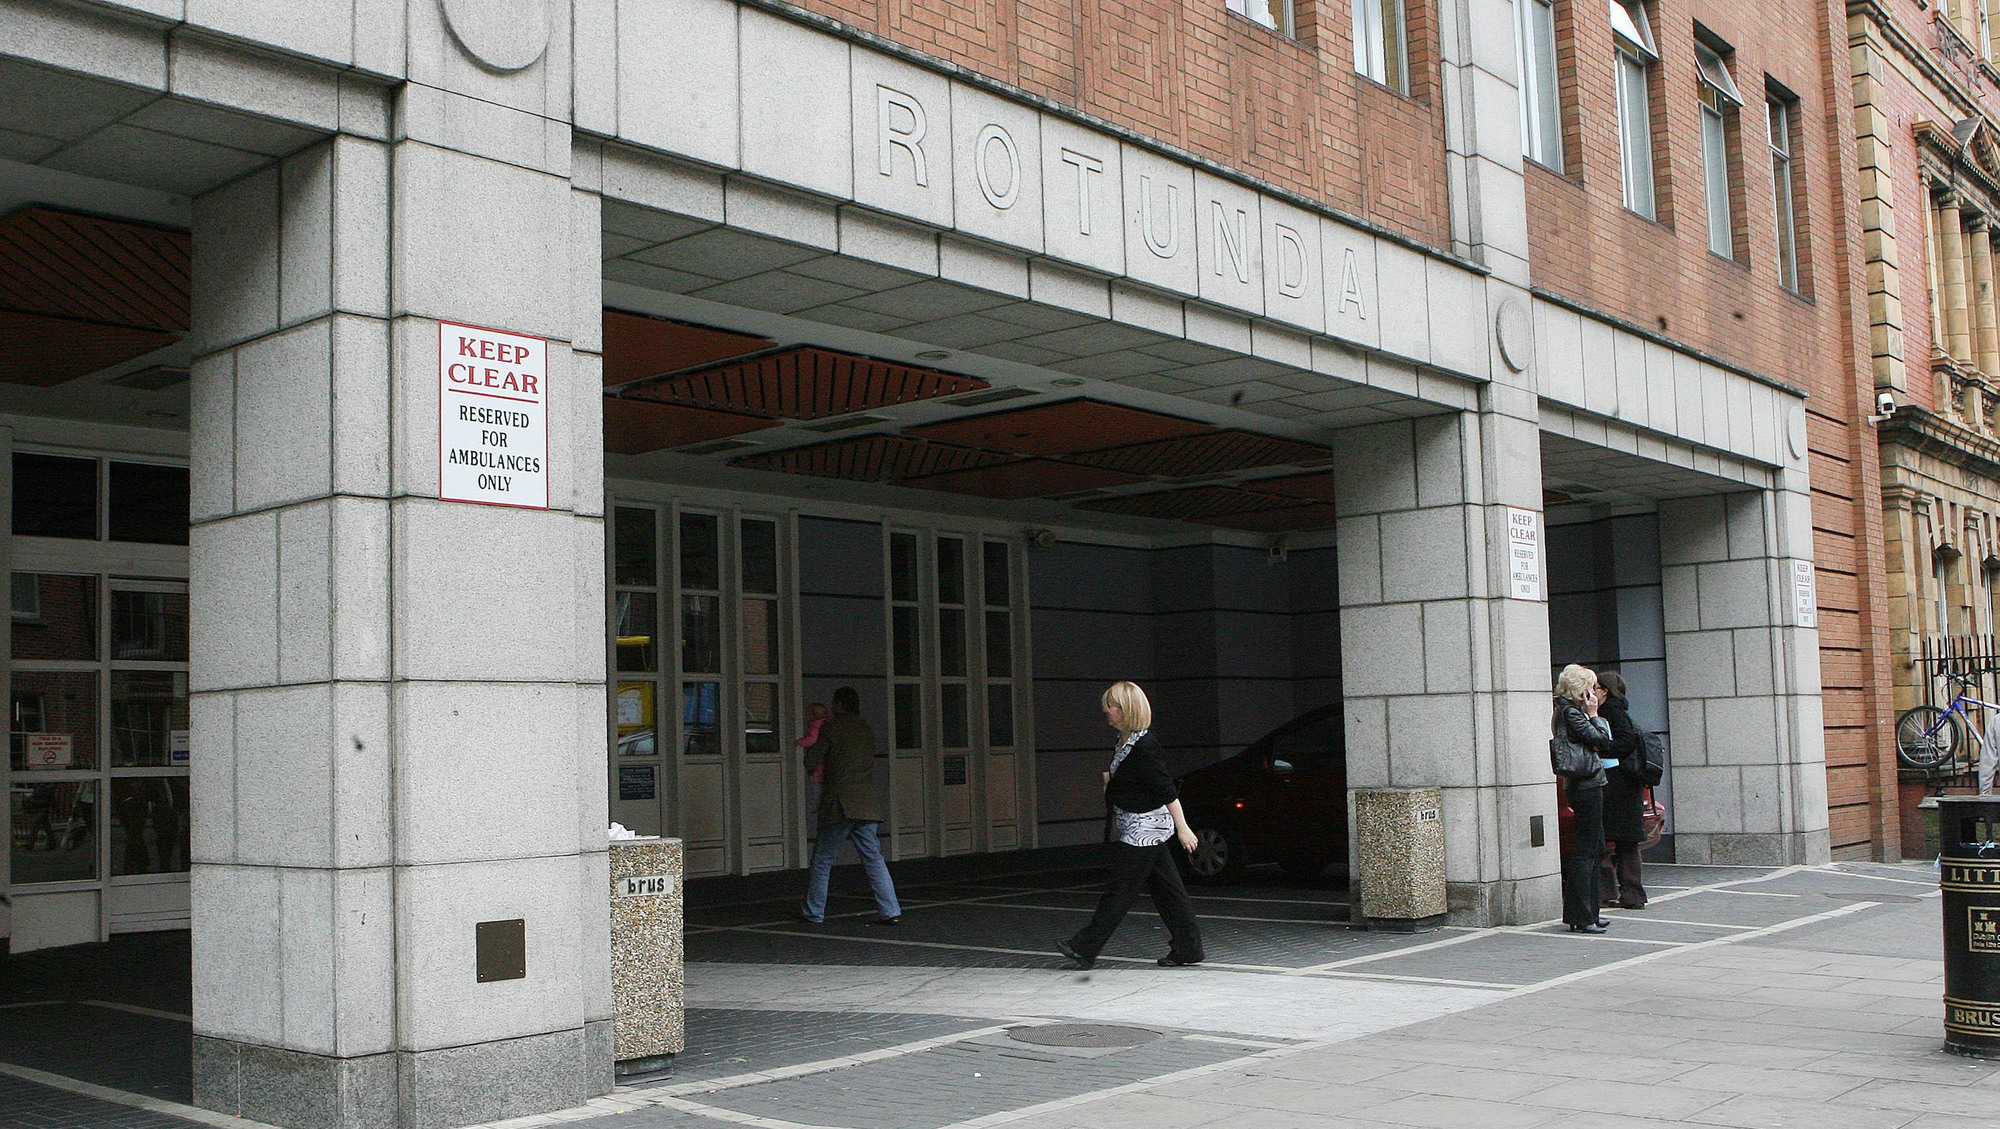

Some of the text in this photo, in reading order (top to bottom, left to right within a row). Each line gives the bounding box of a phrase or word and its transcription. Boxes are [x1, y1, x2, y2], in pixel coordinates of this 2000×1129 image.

[876, 84, 1366, 320] ROTUNDA
[459, 336, 530, 365] KEEP
[448, 363, 539, 394] CLEAR
[459, 405, 530, 428] RESERVED
[481, 430, 508, 448] FOR
[448, 448, 540, 473] AMBULANCES
[477, 473, 511, 491] ONLY
[1512, 513, 1532, 527] KEEP
[1510, 528, 1536, 542] CLEAR
[1420, 810, 1436, 820] brus
[627, 877, 665, 894] brus
[1954, 1009, 2000, 1027] BRUS
